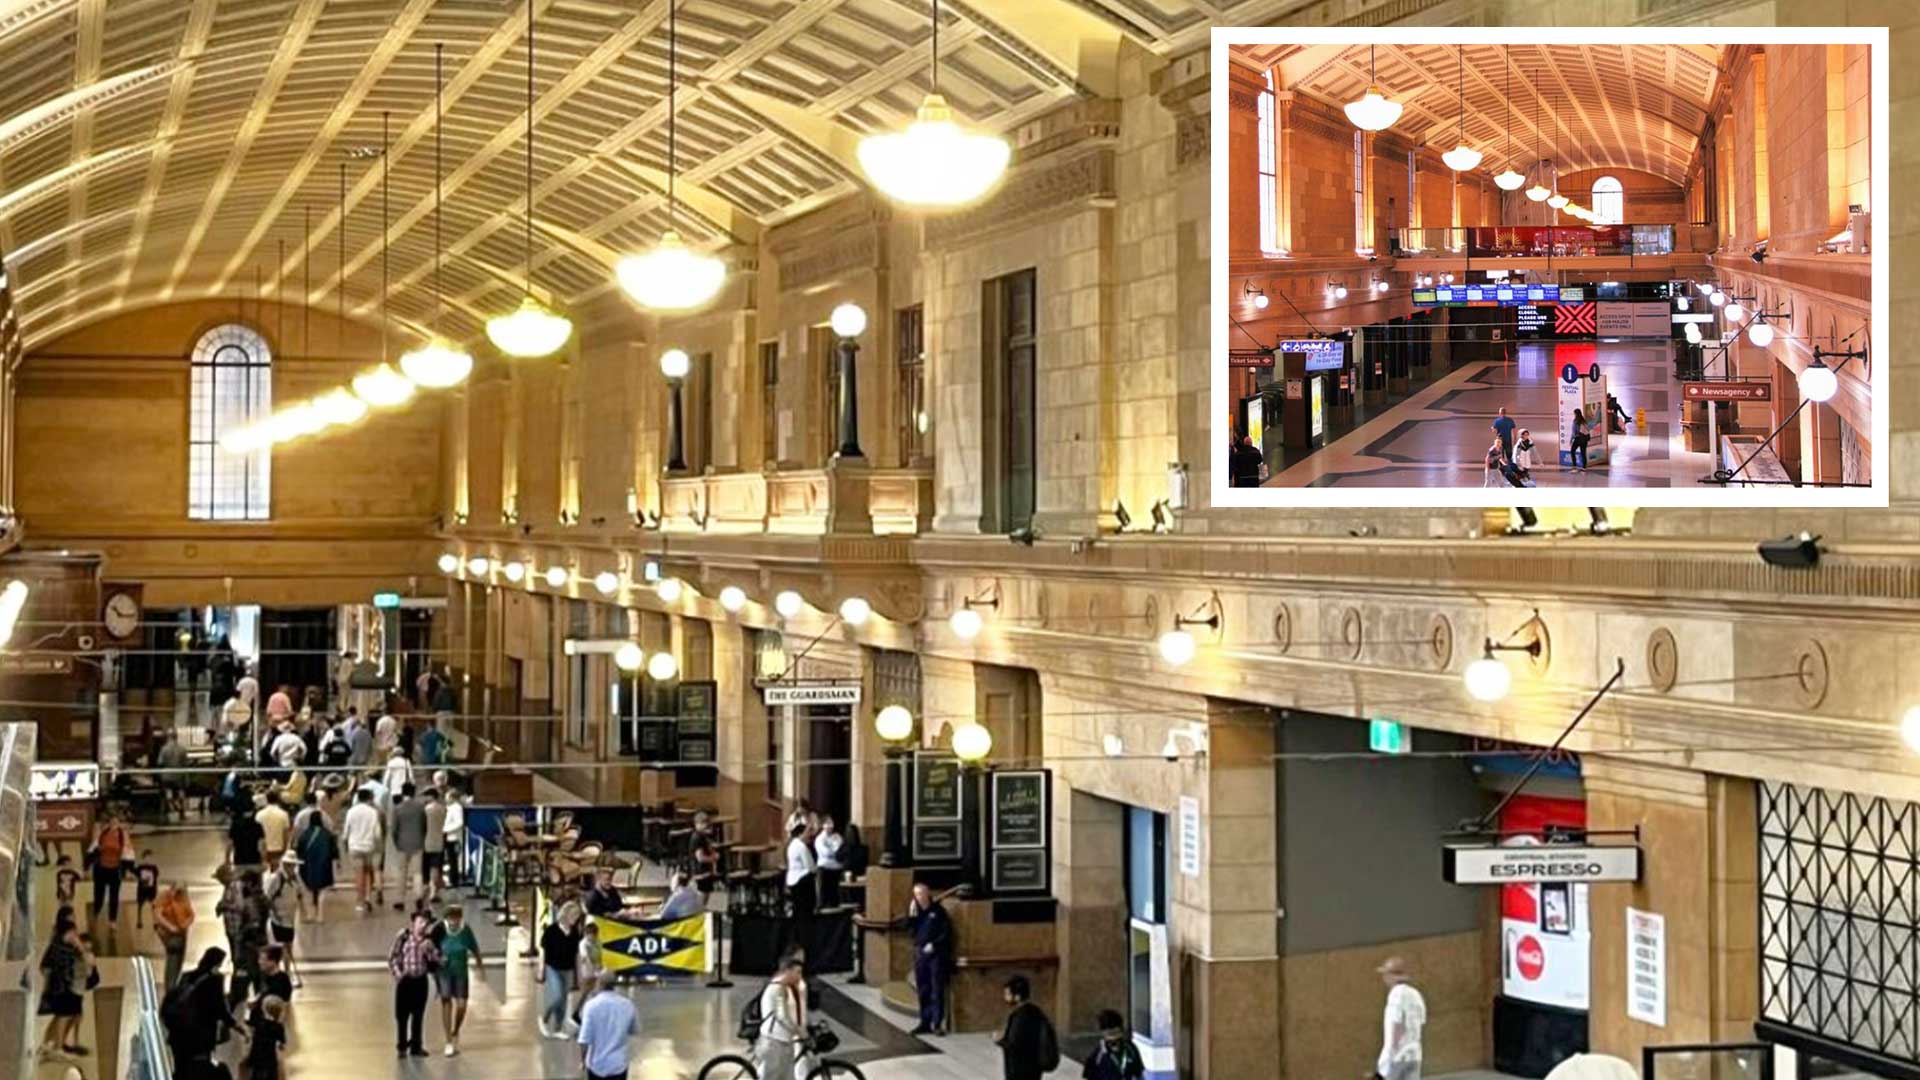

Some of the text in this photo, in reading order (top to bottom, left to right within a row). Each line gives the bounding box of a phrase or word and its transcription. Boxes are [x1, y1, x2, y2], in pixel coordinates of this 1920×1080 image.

[1702, 387, 1751, 397] Newsagency
[769, 690, 856, 700] THE GUARDSMAN
[1490, 862, 1602, 877] ESPRESSO
[627, 937, 671, 954] ADL
